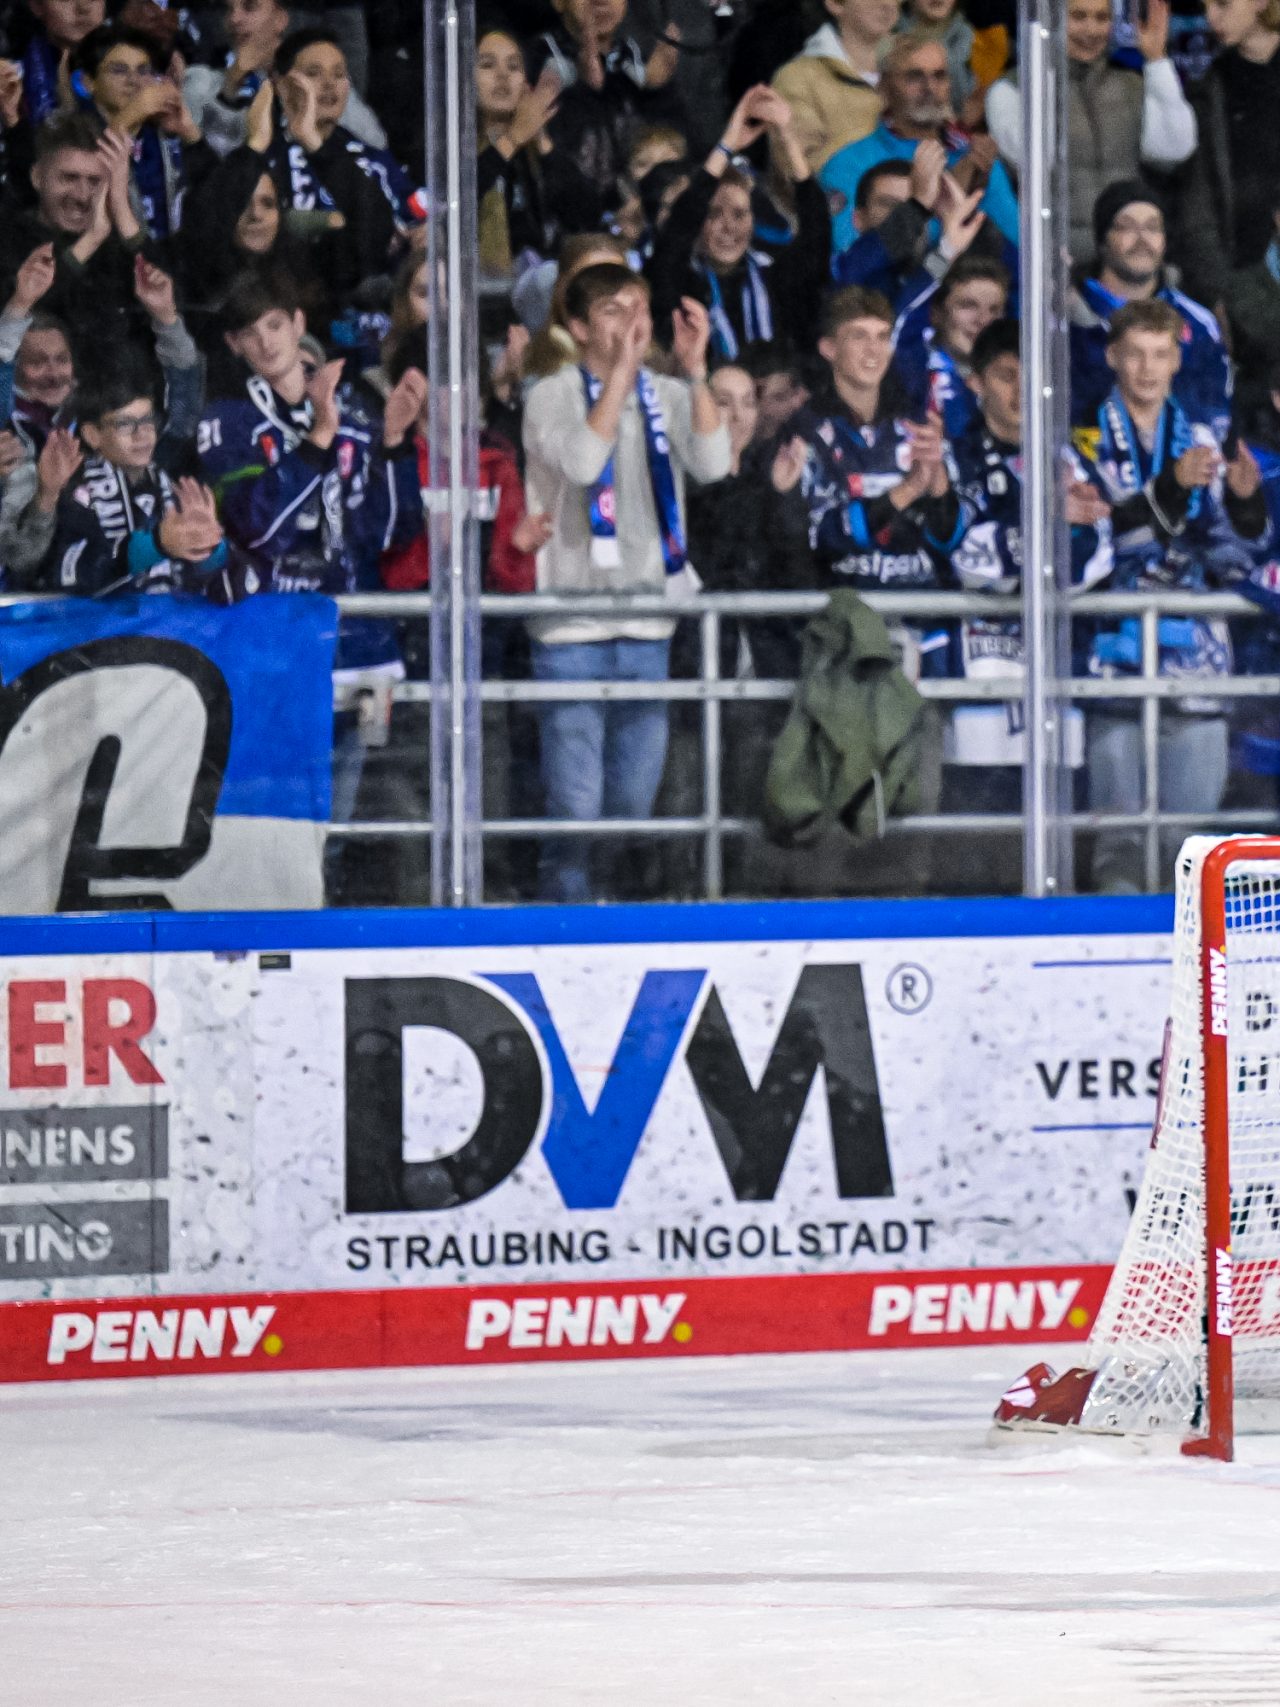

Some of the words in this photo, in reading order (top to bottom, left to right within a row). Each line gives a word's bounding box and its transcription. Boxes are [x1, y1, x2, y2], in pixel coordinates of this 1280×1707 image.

[8, 978, 165, 1089] ER
[344, 963, 895, 1214] DVM
[5, 1124, 136, 1169] NENS
[0, 1220, 114, 1263] TING
[346, 1228, 611, 1271] STRAUBING
[657, 1218, 935, 1262] INGOLSTADT
